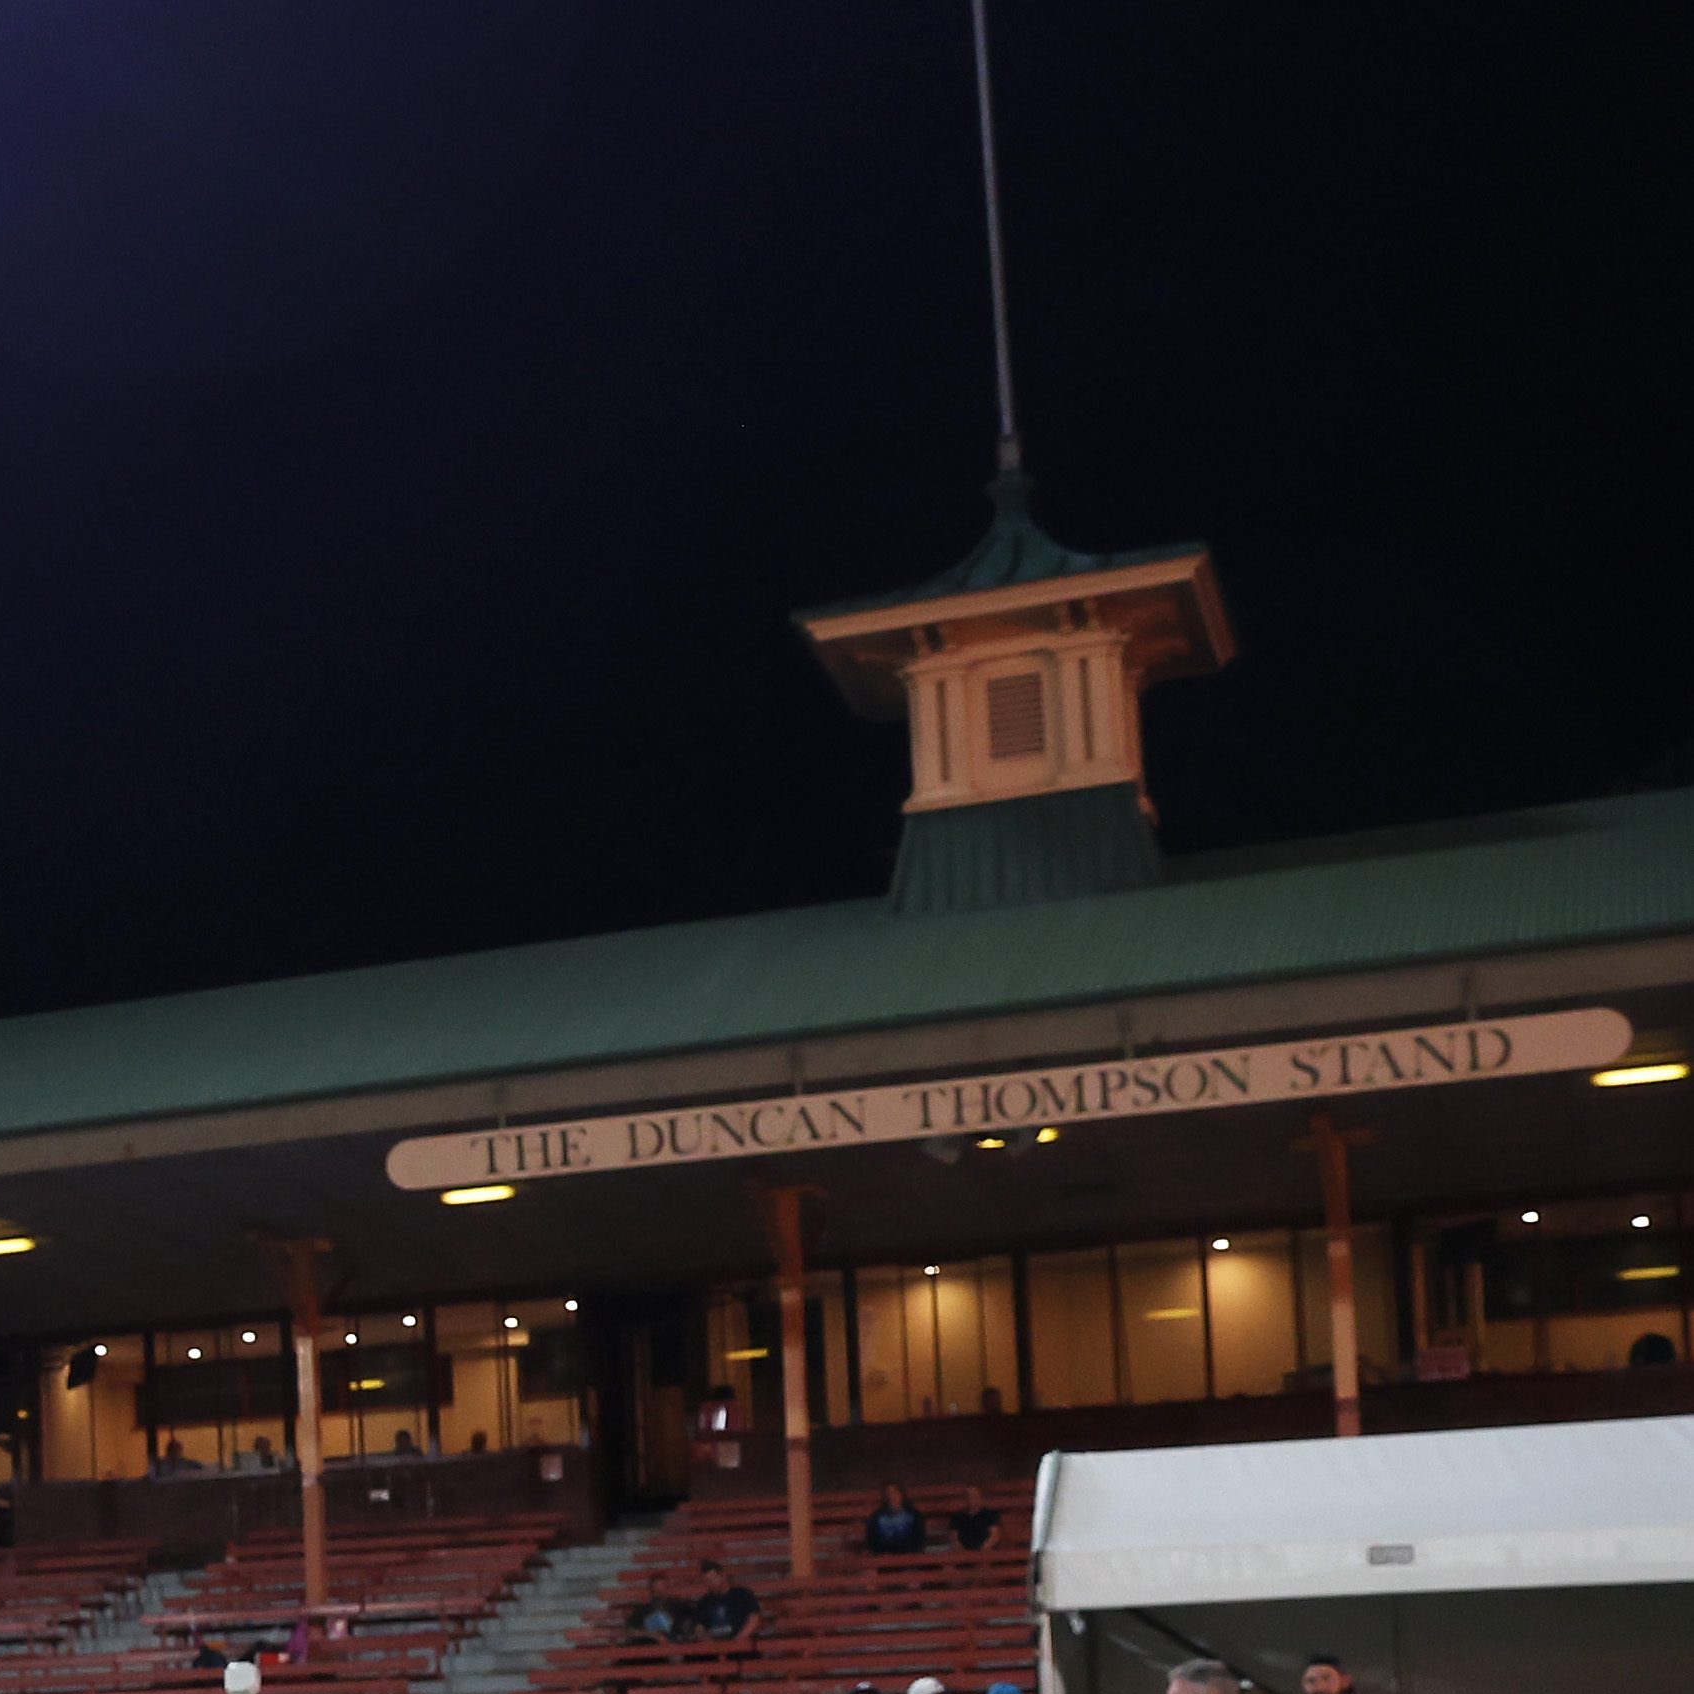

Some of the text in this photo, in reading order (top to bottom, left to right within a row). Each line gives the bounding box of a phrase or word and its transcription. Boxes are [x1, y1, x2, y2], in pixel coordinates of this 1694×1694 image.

[471, 1028, 1512, 1174] THE DUNCAN THOMPSON STAND
